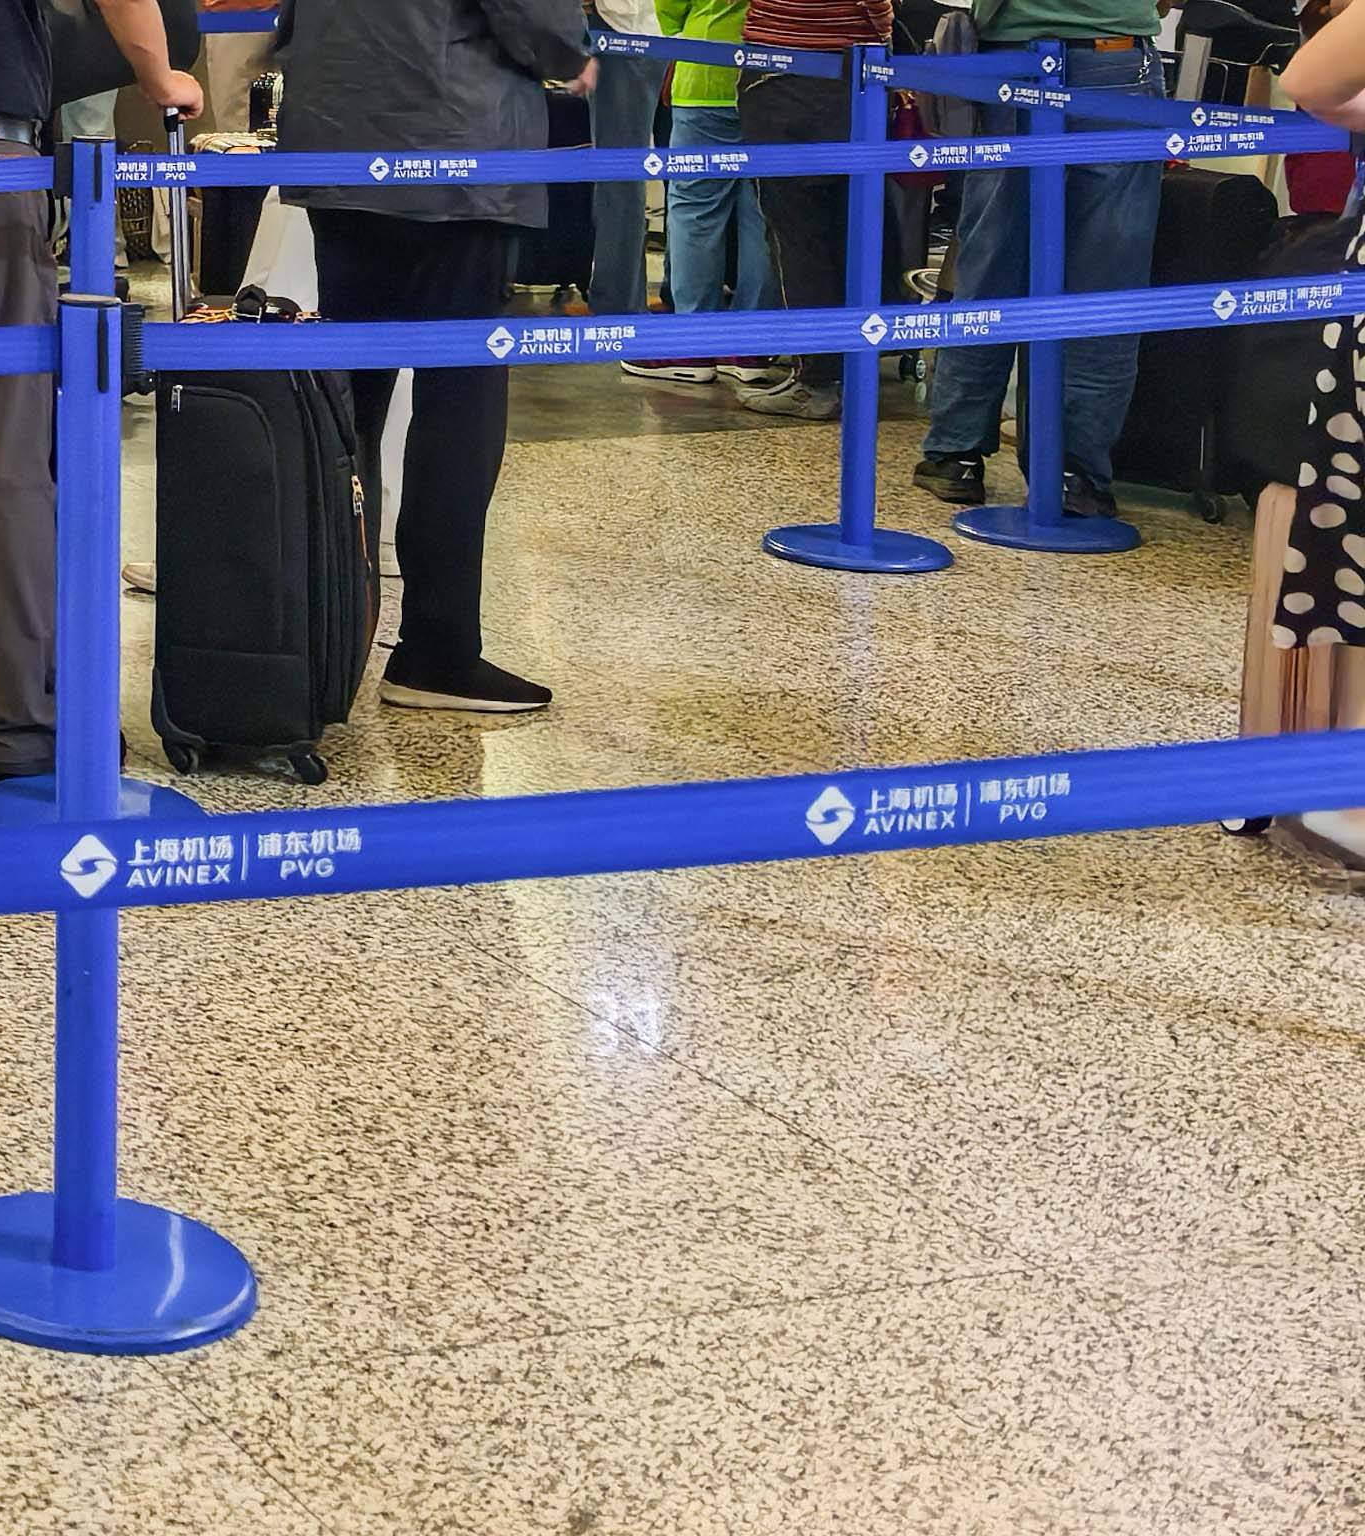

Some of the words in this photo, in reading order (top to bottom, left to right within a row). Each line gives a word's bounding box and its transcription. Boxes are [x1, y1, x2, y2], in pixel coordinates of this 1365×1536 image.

[115, 162, 148, 174] 海机场
[115, 172, 148, 182] VINEX
[164, 171, 186, 181] PVG
[394, 168, 432, 179] AVINEX
[447, 168, 469, 178] PVG
[1243, 289, 1289, 304] 上海机场
[1296, 283, 1343, 300] 浦东机场
[1241, 302, 1288, 316] AVINEX
[1306, 298, 1334, 311] PVG
[892, 312, 941, 329] 上海机场
[952, 310, 1001, 326] 浦东机场
[520, 328, 572, 344] 上海机场
[584, 326, 636, 341] 浦东机场
[892, 326, 941, 340] AVINEX
[963, 324, 990, 336] PVG
[520, 342, 572, 356] AVINEX
[595, 339, 623, 352] PVG
[865, 783, 958, 814] 上海机场
[980, 773, 1070, 803] 浦东机场
[864, 811, 955, 835] AVINEX
[1000, 802, 1047, 824] PVG
[127, 835, 234, 865] 上海机场
[258, 828, 362, 857] 浦东机场
[126, 865, 231, 888] AVINEX
[280, 858, 335, 880] PVG
